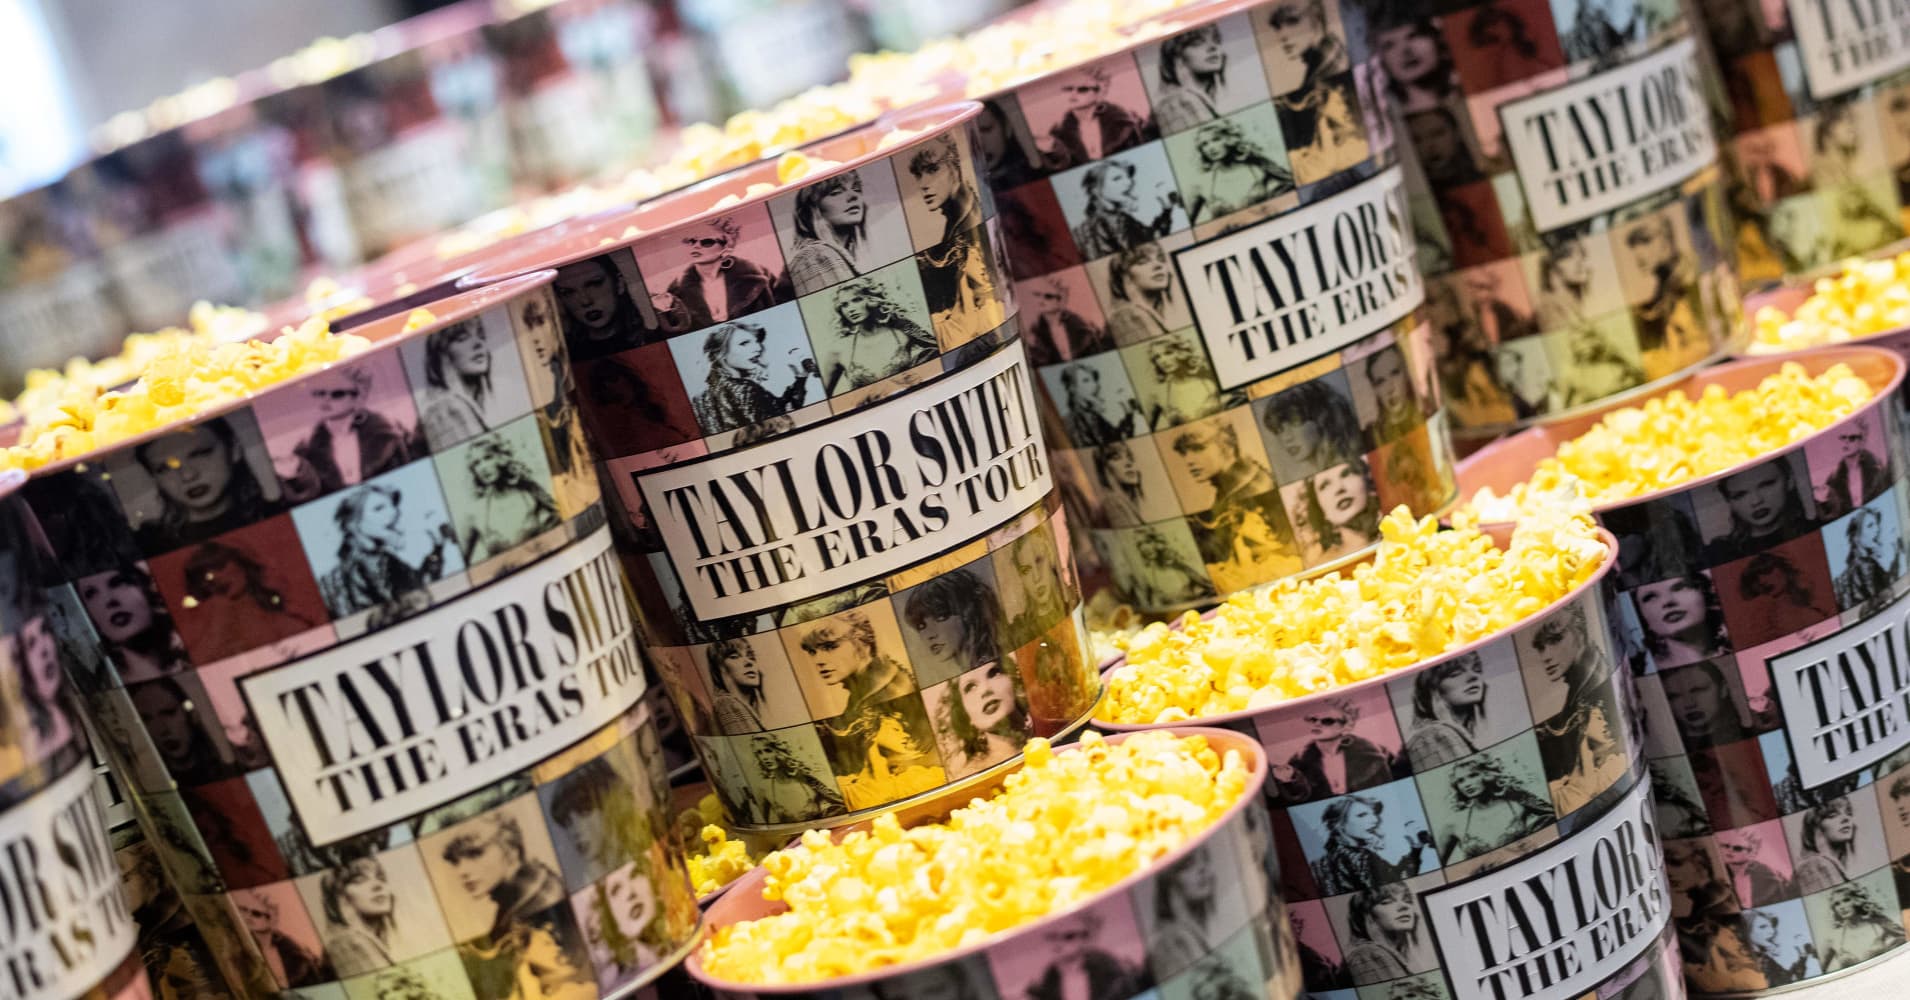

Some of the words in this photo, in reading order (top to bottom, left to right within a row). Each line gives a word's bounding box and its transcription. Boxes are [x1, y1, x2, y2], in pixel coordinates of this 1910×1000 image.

[1524, 66, 1686, 172] TAYLOR
[1543, 156, 1635, 205] THE
[1203, 201, 1388, 327] TAYLOR
[1228, 302, 1326, 362] THE
[664, 428, 907, 560] TAYLOR
[909, 362, 1033, 488] SWIFT
[696, 542, 804, 599] THE
[813, 492, 950, 573] ERAS
[955, 442, 1044, 517] TOUR
[278, 602, 546, 771] TAYLOR
[543, 549, 626, 666] SWIF
[1795, 616, 1910, 731] TAYL
[316, 739, 449, 814] THE
[455, 672, 585, 767] ERAS
[1813, 702, 1898, 762] THE
[1453, 819, 1645, 972] TAYLOR
[1477, 939, 1583, 1000] THE
[1588, 878, 1662, 962] ERAS
[3, 915, 96, 999] RAS
